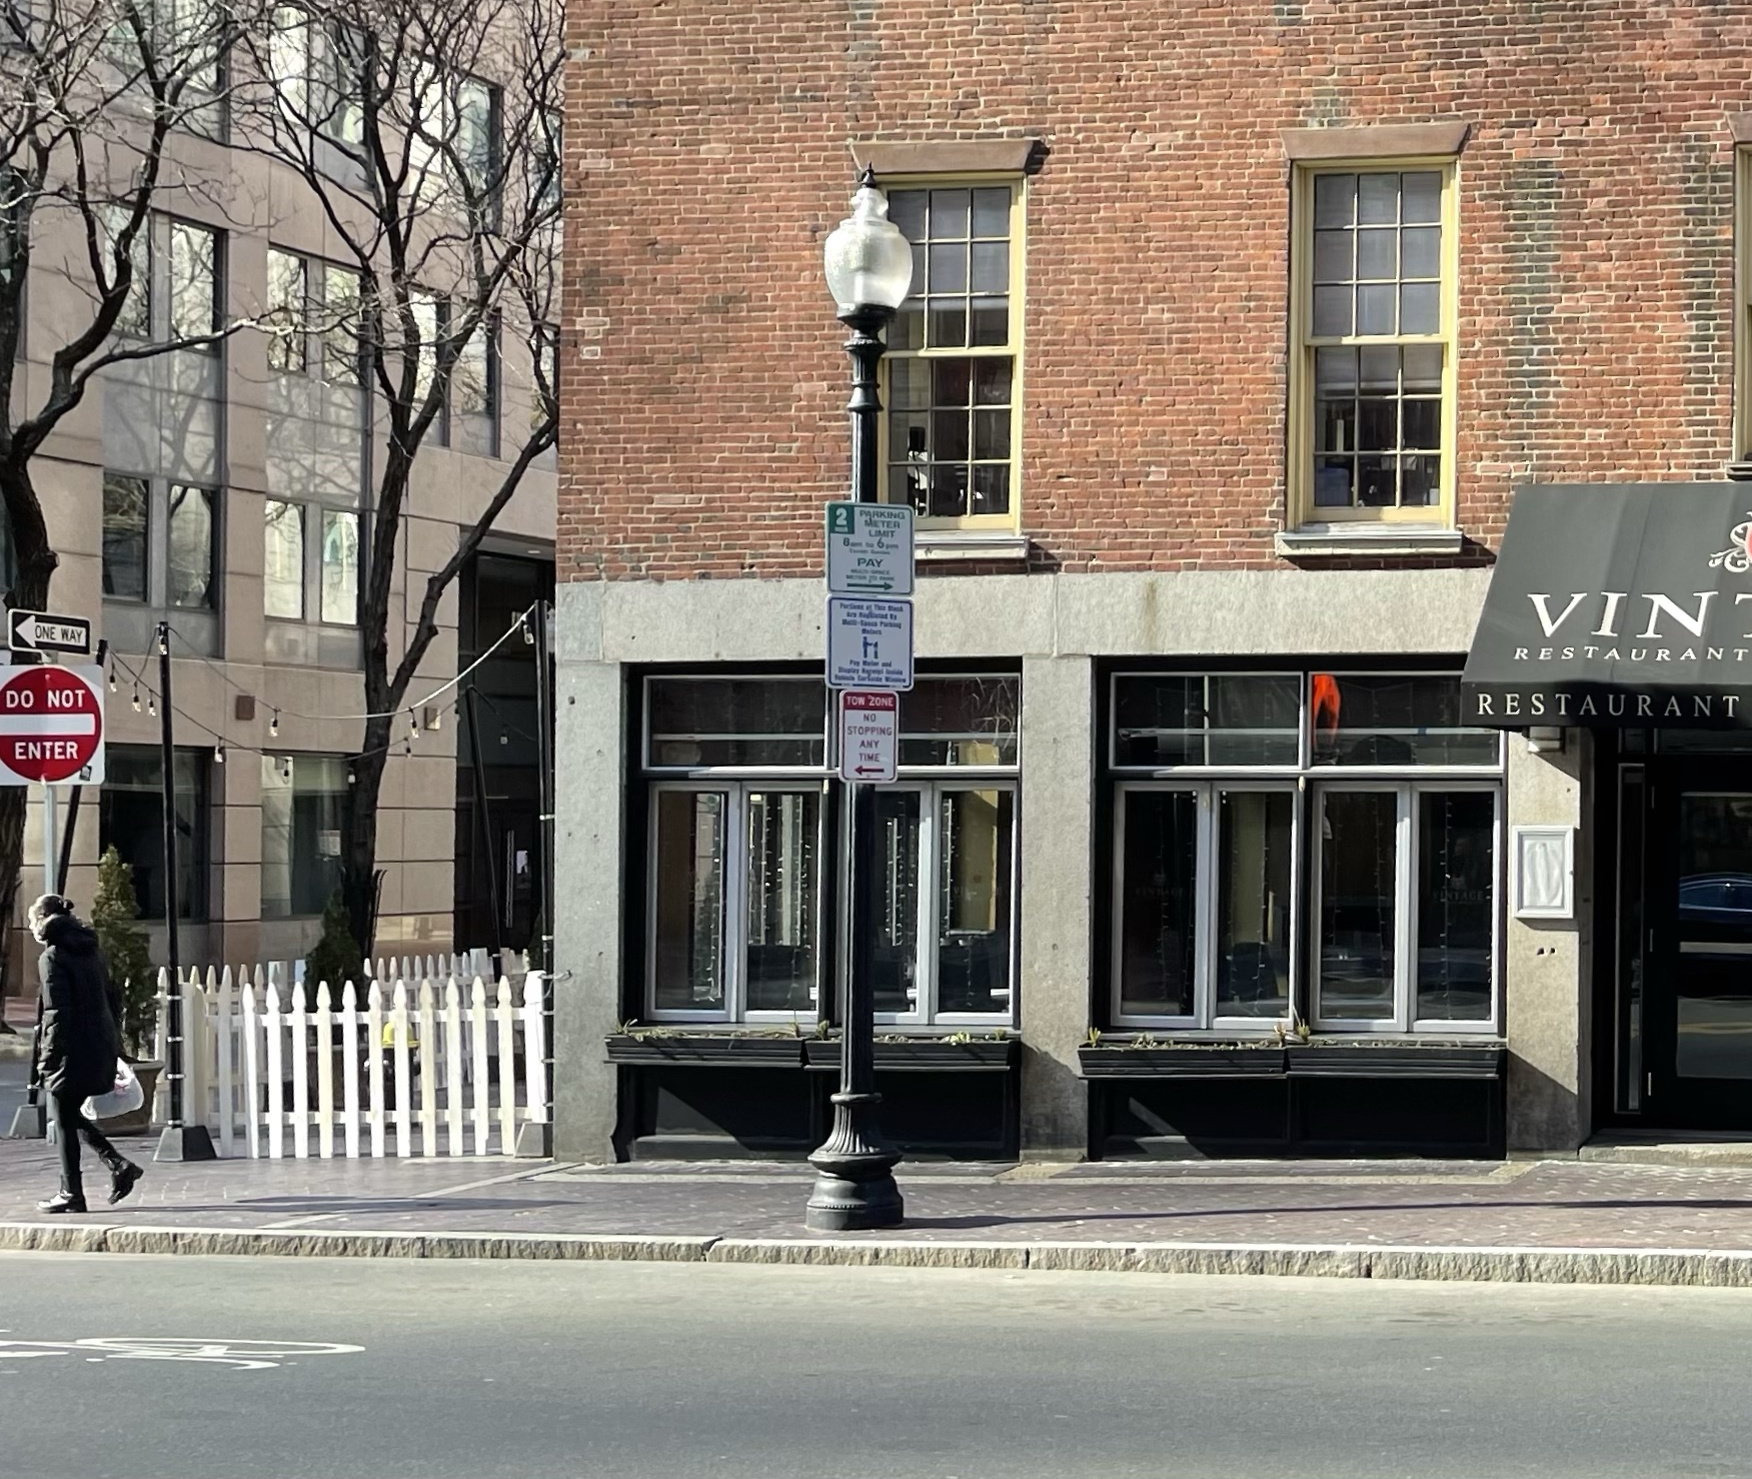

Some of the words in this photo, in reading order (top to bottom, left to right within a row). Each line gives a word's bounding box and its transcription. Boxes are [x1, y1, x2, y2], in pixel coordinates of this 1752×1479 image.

[836, 508, 847, 525] 2
[860, 510, 905, 520] PARKING
[864, 519, 900, 528] METER
[869, 530, 896, 538] LIMIT
[857, 558, 883, 568] PAY
[35, 624, 56, 640] ONE
[61, 627, 83, 643] WAY
[1513, 645, 1750, 662] RESTAURANT
[6, 689, 34, 708] DO
[47, 689, 85, 708] NOT
[846, 696, 865, 706] TOW
[868, 696, 894, 706] ZONE
[1477, 691, 1741, 718] RESTAURANT
[863, 713, 876, 722] NO
[847, 726, 892, 736] STOPPING
[859, 740, 880, 748] ANY
[15, 741, 78, 760] ENTER
[859, 752, 880, 762] TIME
